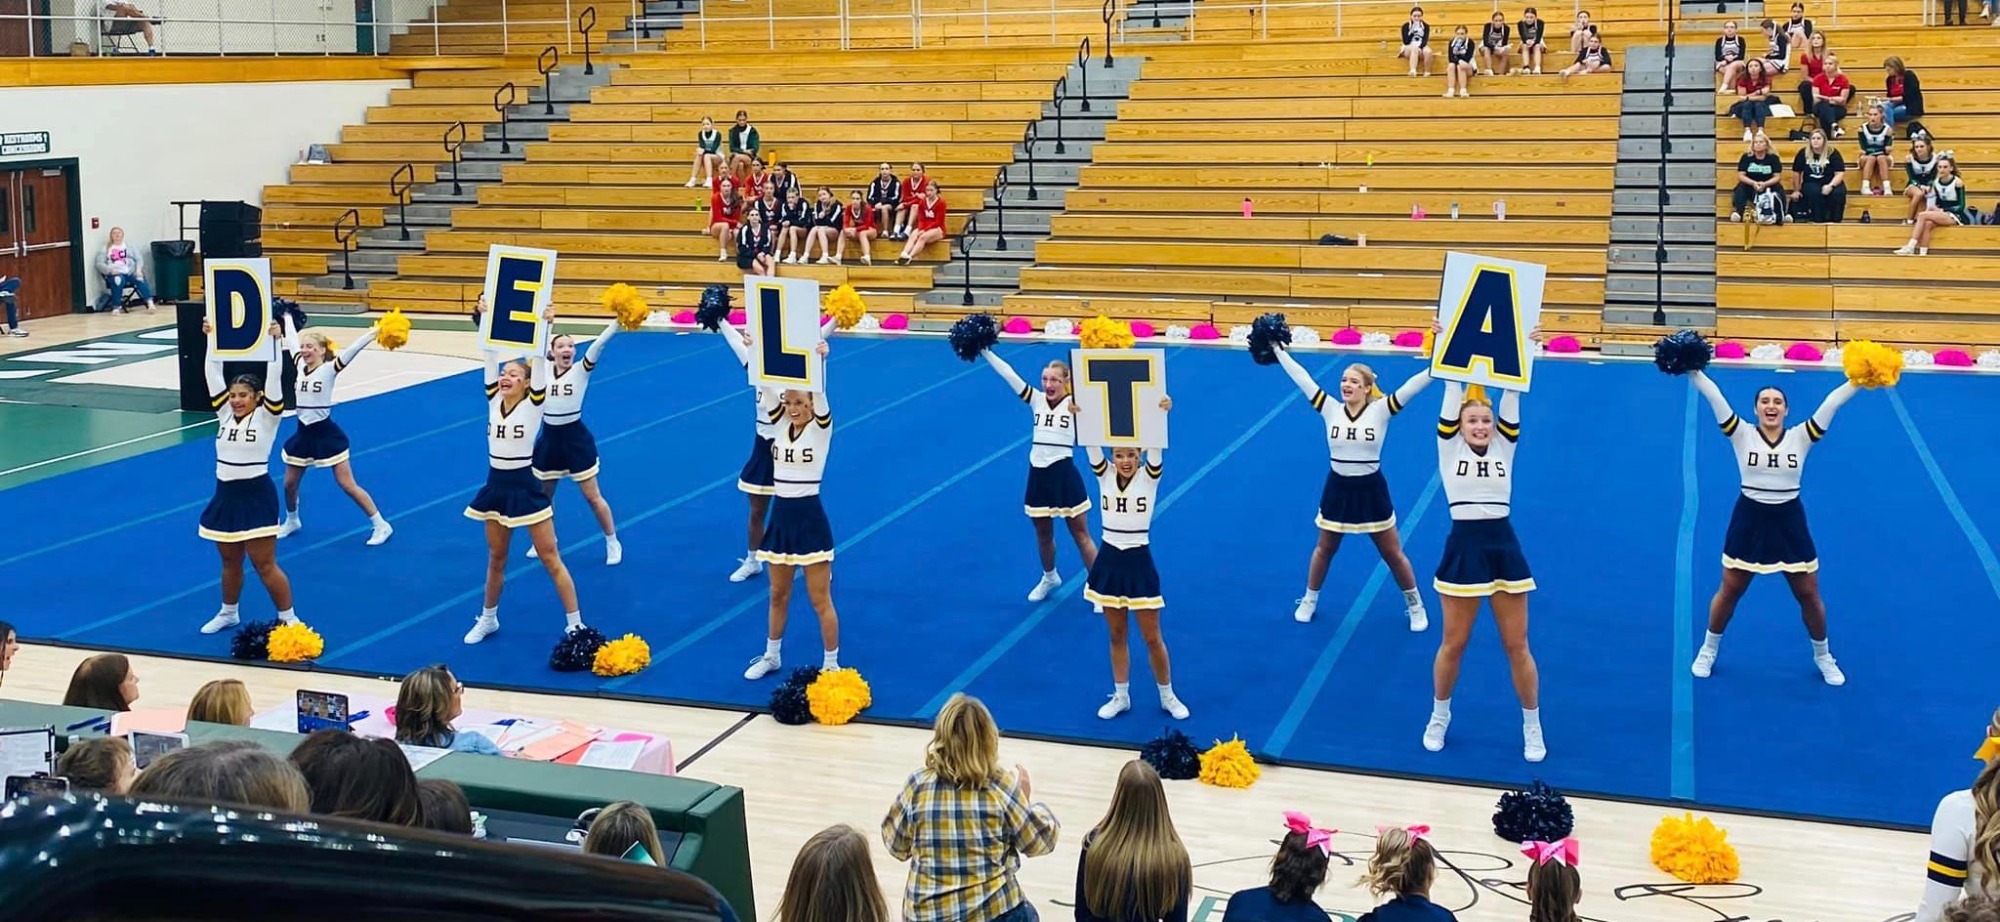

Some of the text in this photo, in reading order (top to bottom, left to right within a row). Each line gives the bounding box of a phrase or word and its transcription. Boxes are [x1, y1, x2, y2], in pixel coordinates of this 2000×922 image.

[211, 265, 267, 356] D
[486, 253, 547, 348] E
[756, 283, 811, 384] L
[1434, 264, 1528, 384] A
[551, 384, 573, 396] HS
[1082, 355, 1156, 442] T
